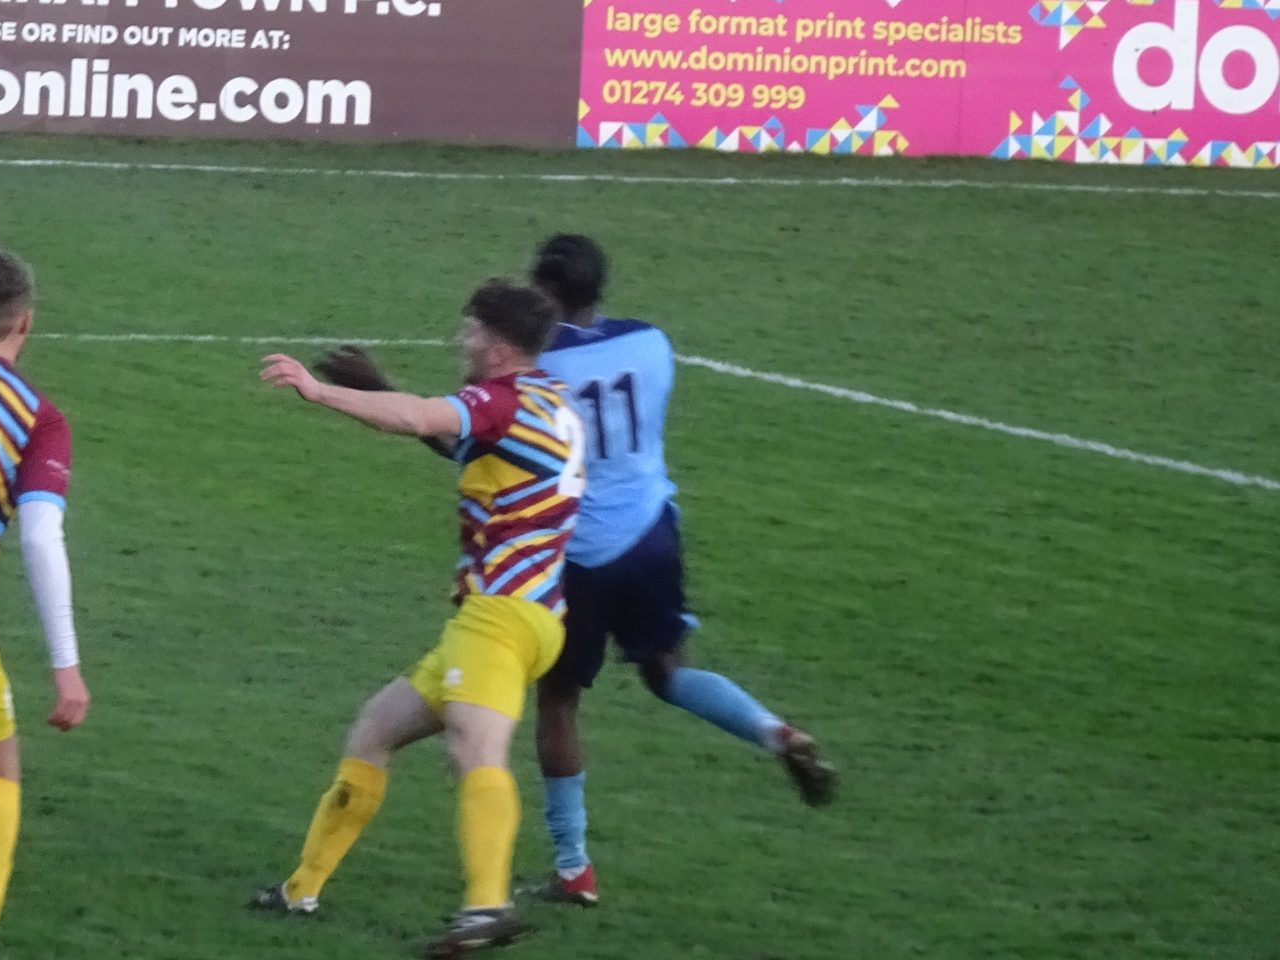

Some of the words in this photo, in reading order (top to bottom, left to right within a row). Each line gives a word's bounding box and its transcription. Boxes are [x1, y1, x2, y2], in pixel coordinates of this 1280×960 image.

[22, 23, 57, 43] OR
[62, 24, 118, 45] FIND
[123, 26, 173, 46] OUT
[178, 28, 246, 49] MORE
[251, 30, 291, 50] AT:
[606, 6, 681, 38] large
[688, 9, 787, 37] format
[796, 12, 866, 43] print
[872, 16, 1023, 46] specialists
[604, 45, 967, 80] www.dominionprint.com
[602, 79, 684, 106] 01274
[690, 82, 745, 108] 309
[751, 84, 806, 110] 999
[578, 372, 638, 460] 11
